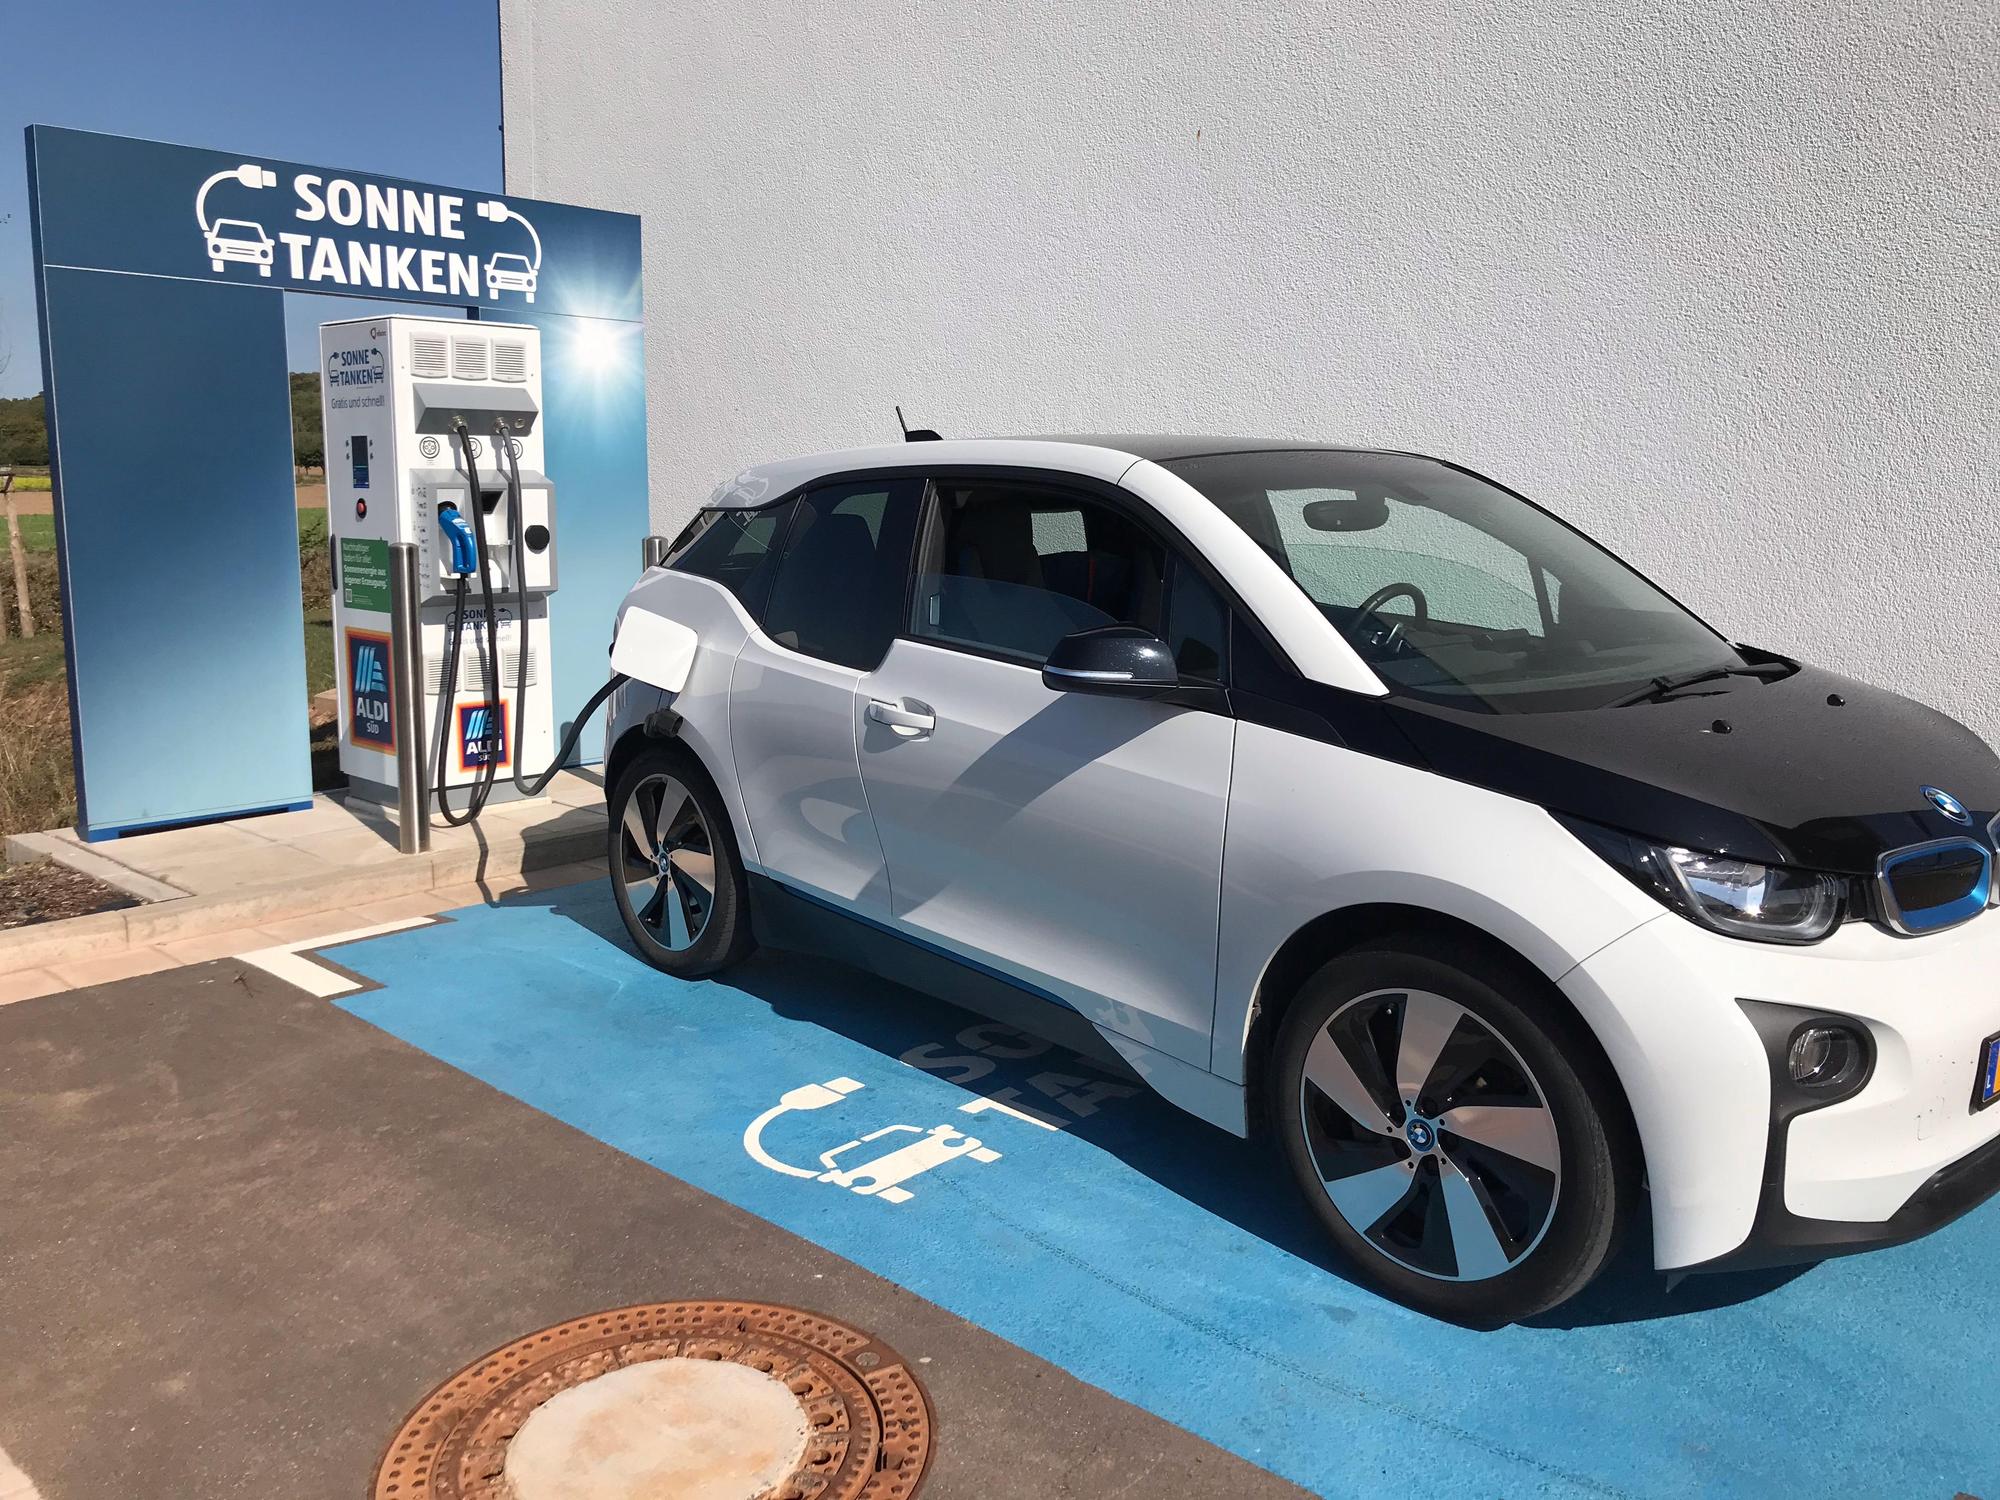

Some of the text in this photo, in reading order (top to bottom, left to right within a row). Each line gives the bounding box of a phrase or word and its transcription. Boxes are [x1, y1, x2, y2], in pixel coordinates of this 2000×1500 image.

[293, 174, 465, 240] SONNE
[279, 232, 480, 297] TANKEN
[341, 349, 370, 367] SONNE
[340, 369, 373, 386] TANKEN
[331, 395, 385, 409] Gratis und schnell!
[463, 609, 496, 619] SONE
[356, 697, 388, 723] ALDI
[366, 720, 379, 734] SÜD
